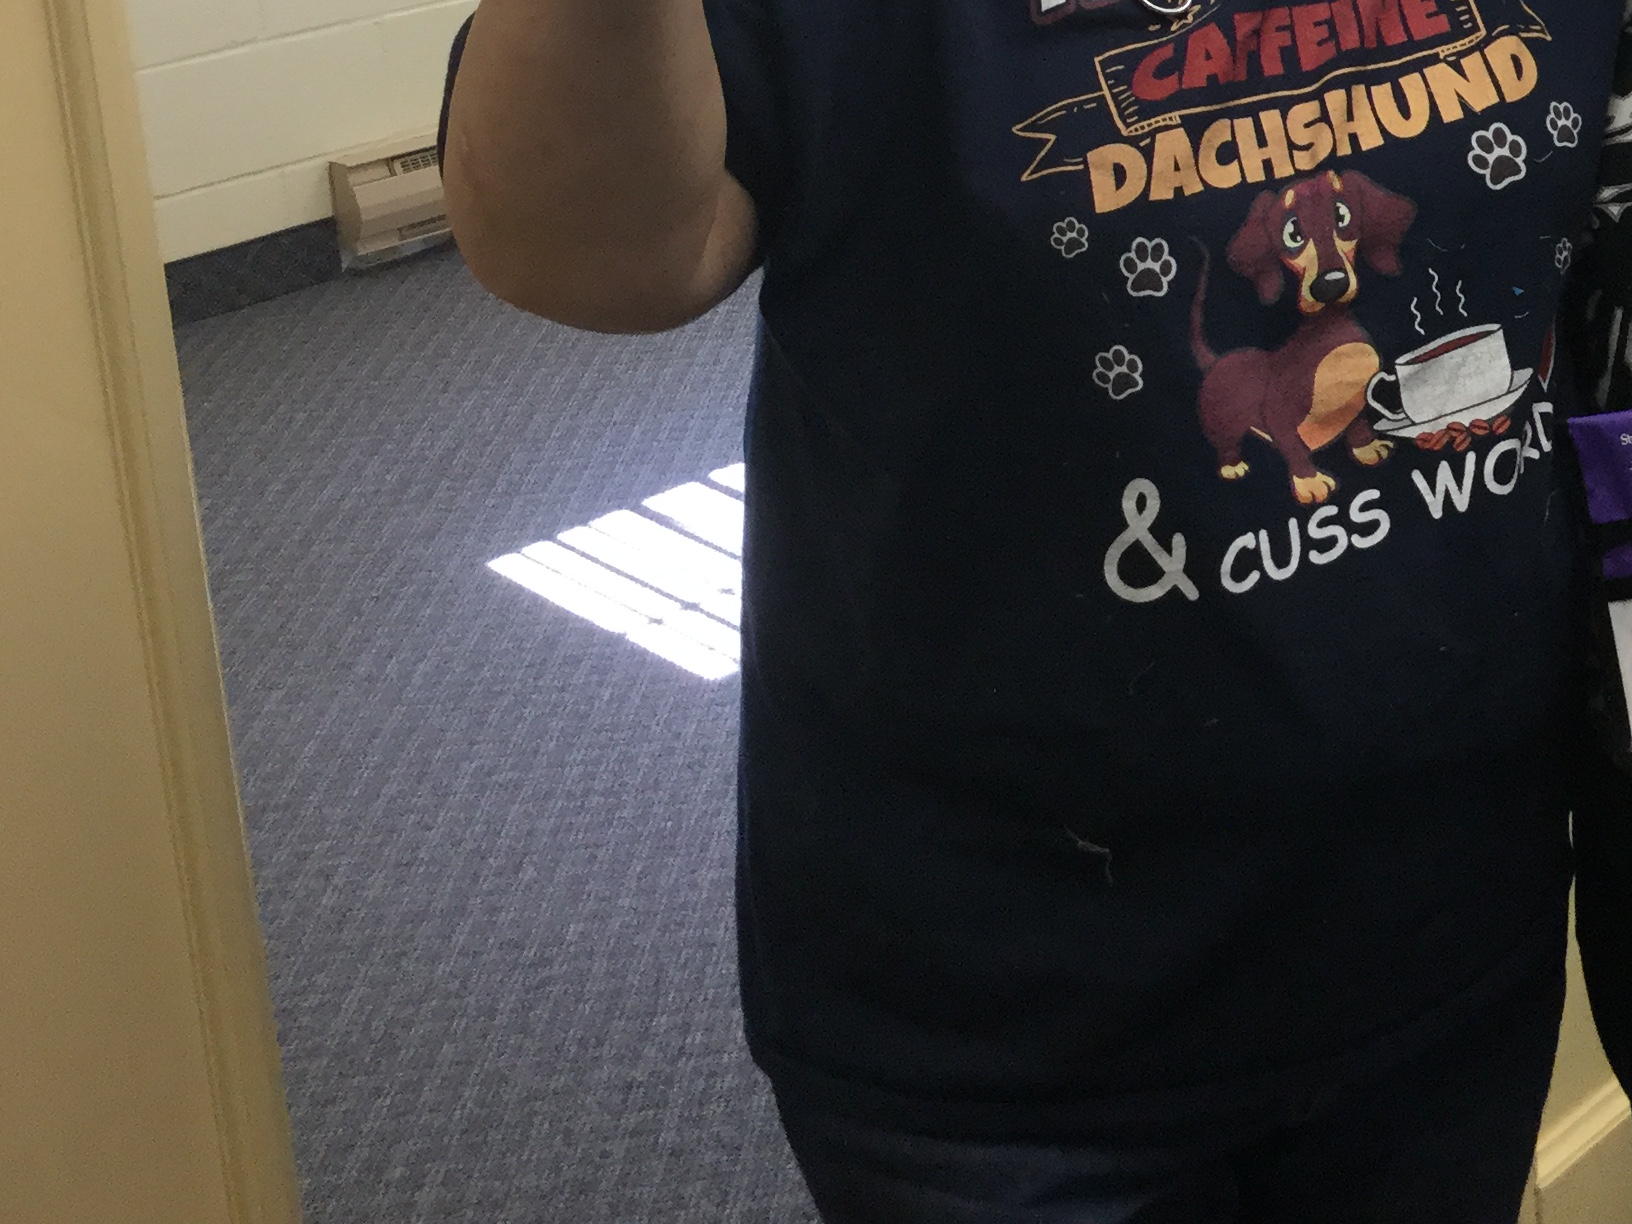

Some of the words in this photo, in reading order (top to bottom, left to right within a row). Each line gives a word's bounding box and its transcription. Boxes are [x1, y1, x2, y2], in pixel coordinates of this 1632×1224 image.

[1086, 35, 1539, 214] DACHSHUND
[1103, 476, 1200, 603] &
[1219, 488, 1392, 594] CUSS
